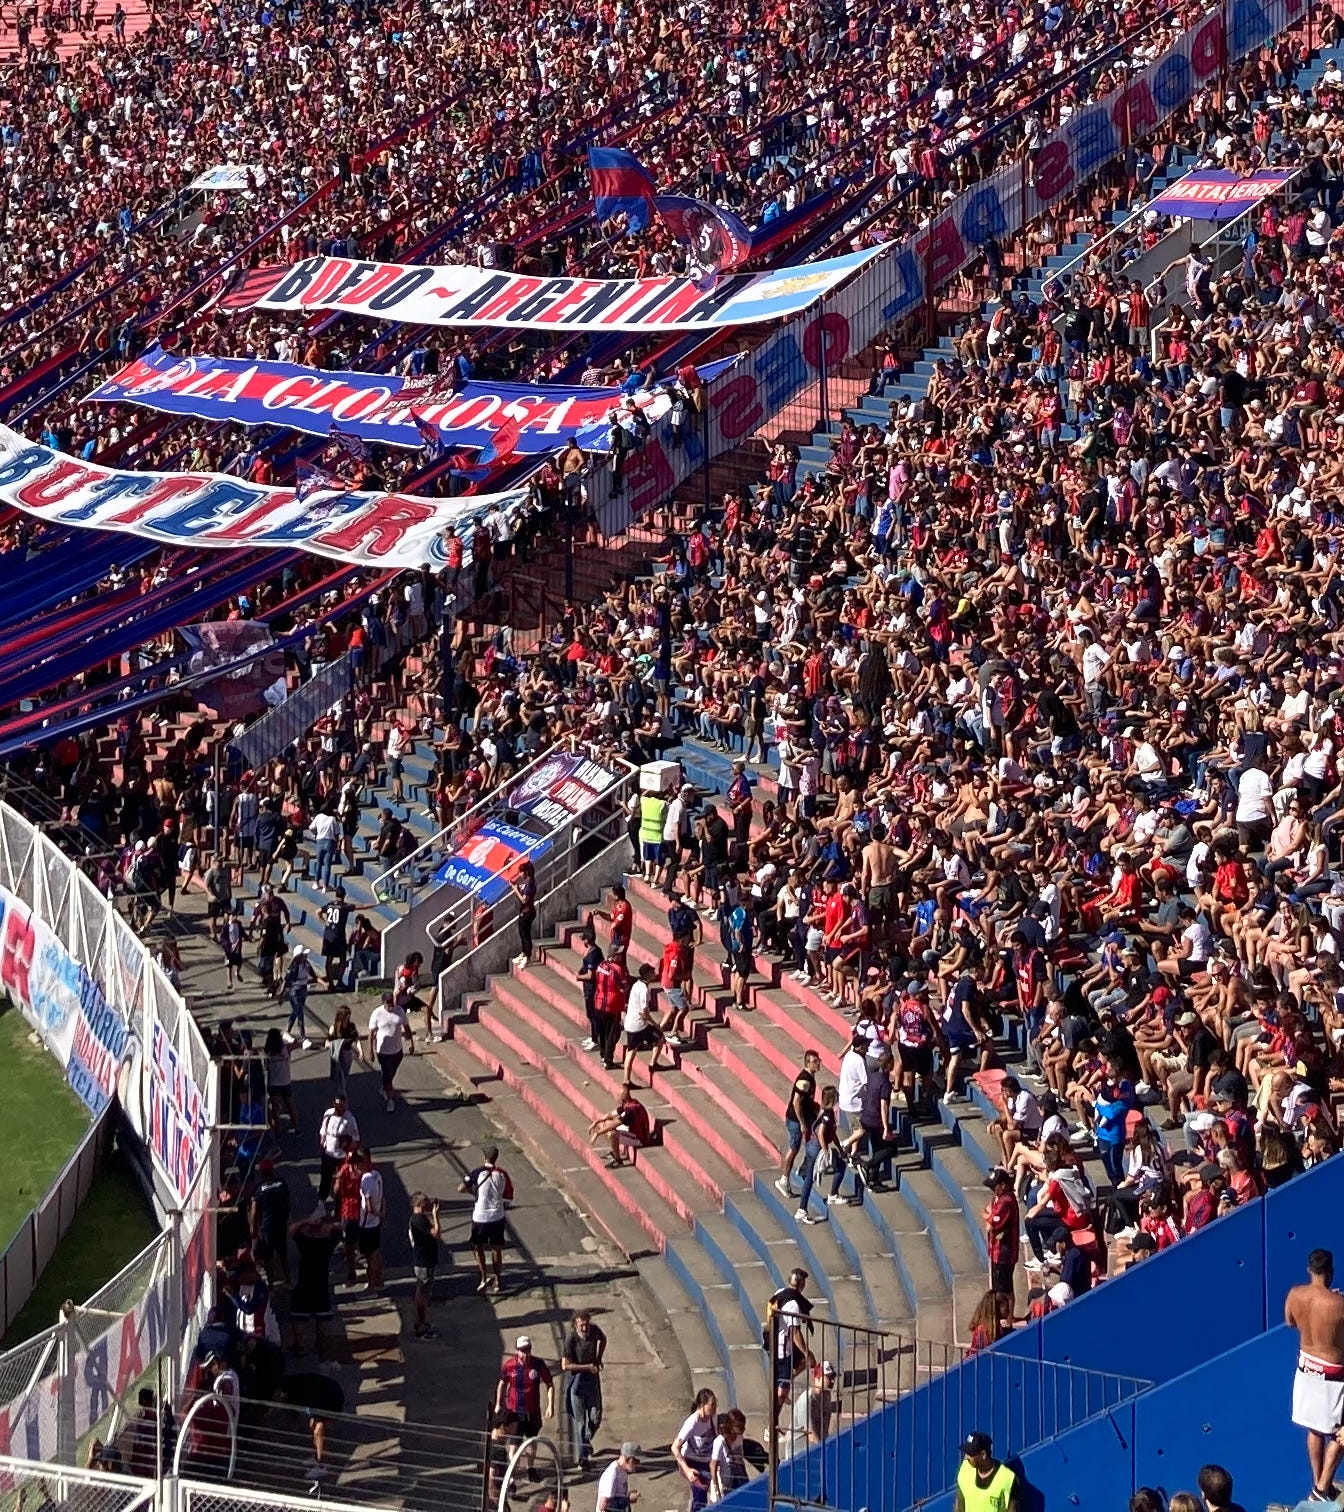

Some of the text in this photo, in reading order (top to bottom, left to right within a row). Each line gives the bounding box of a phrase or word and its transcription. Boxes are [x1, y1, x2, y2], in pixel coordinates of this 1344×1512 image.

[266, 258, 742, 324] BOEDO ARGENTINA
[172, 366, 258, 403] LA
[497, 825, 544, 850] Cuervo
[327, 907, 340, 924] 20
